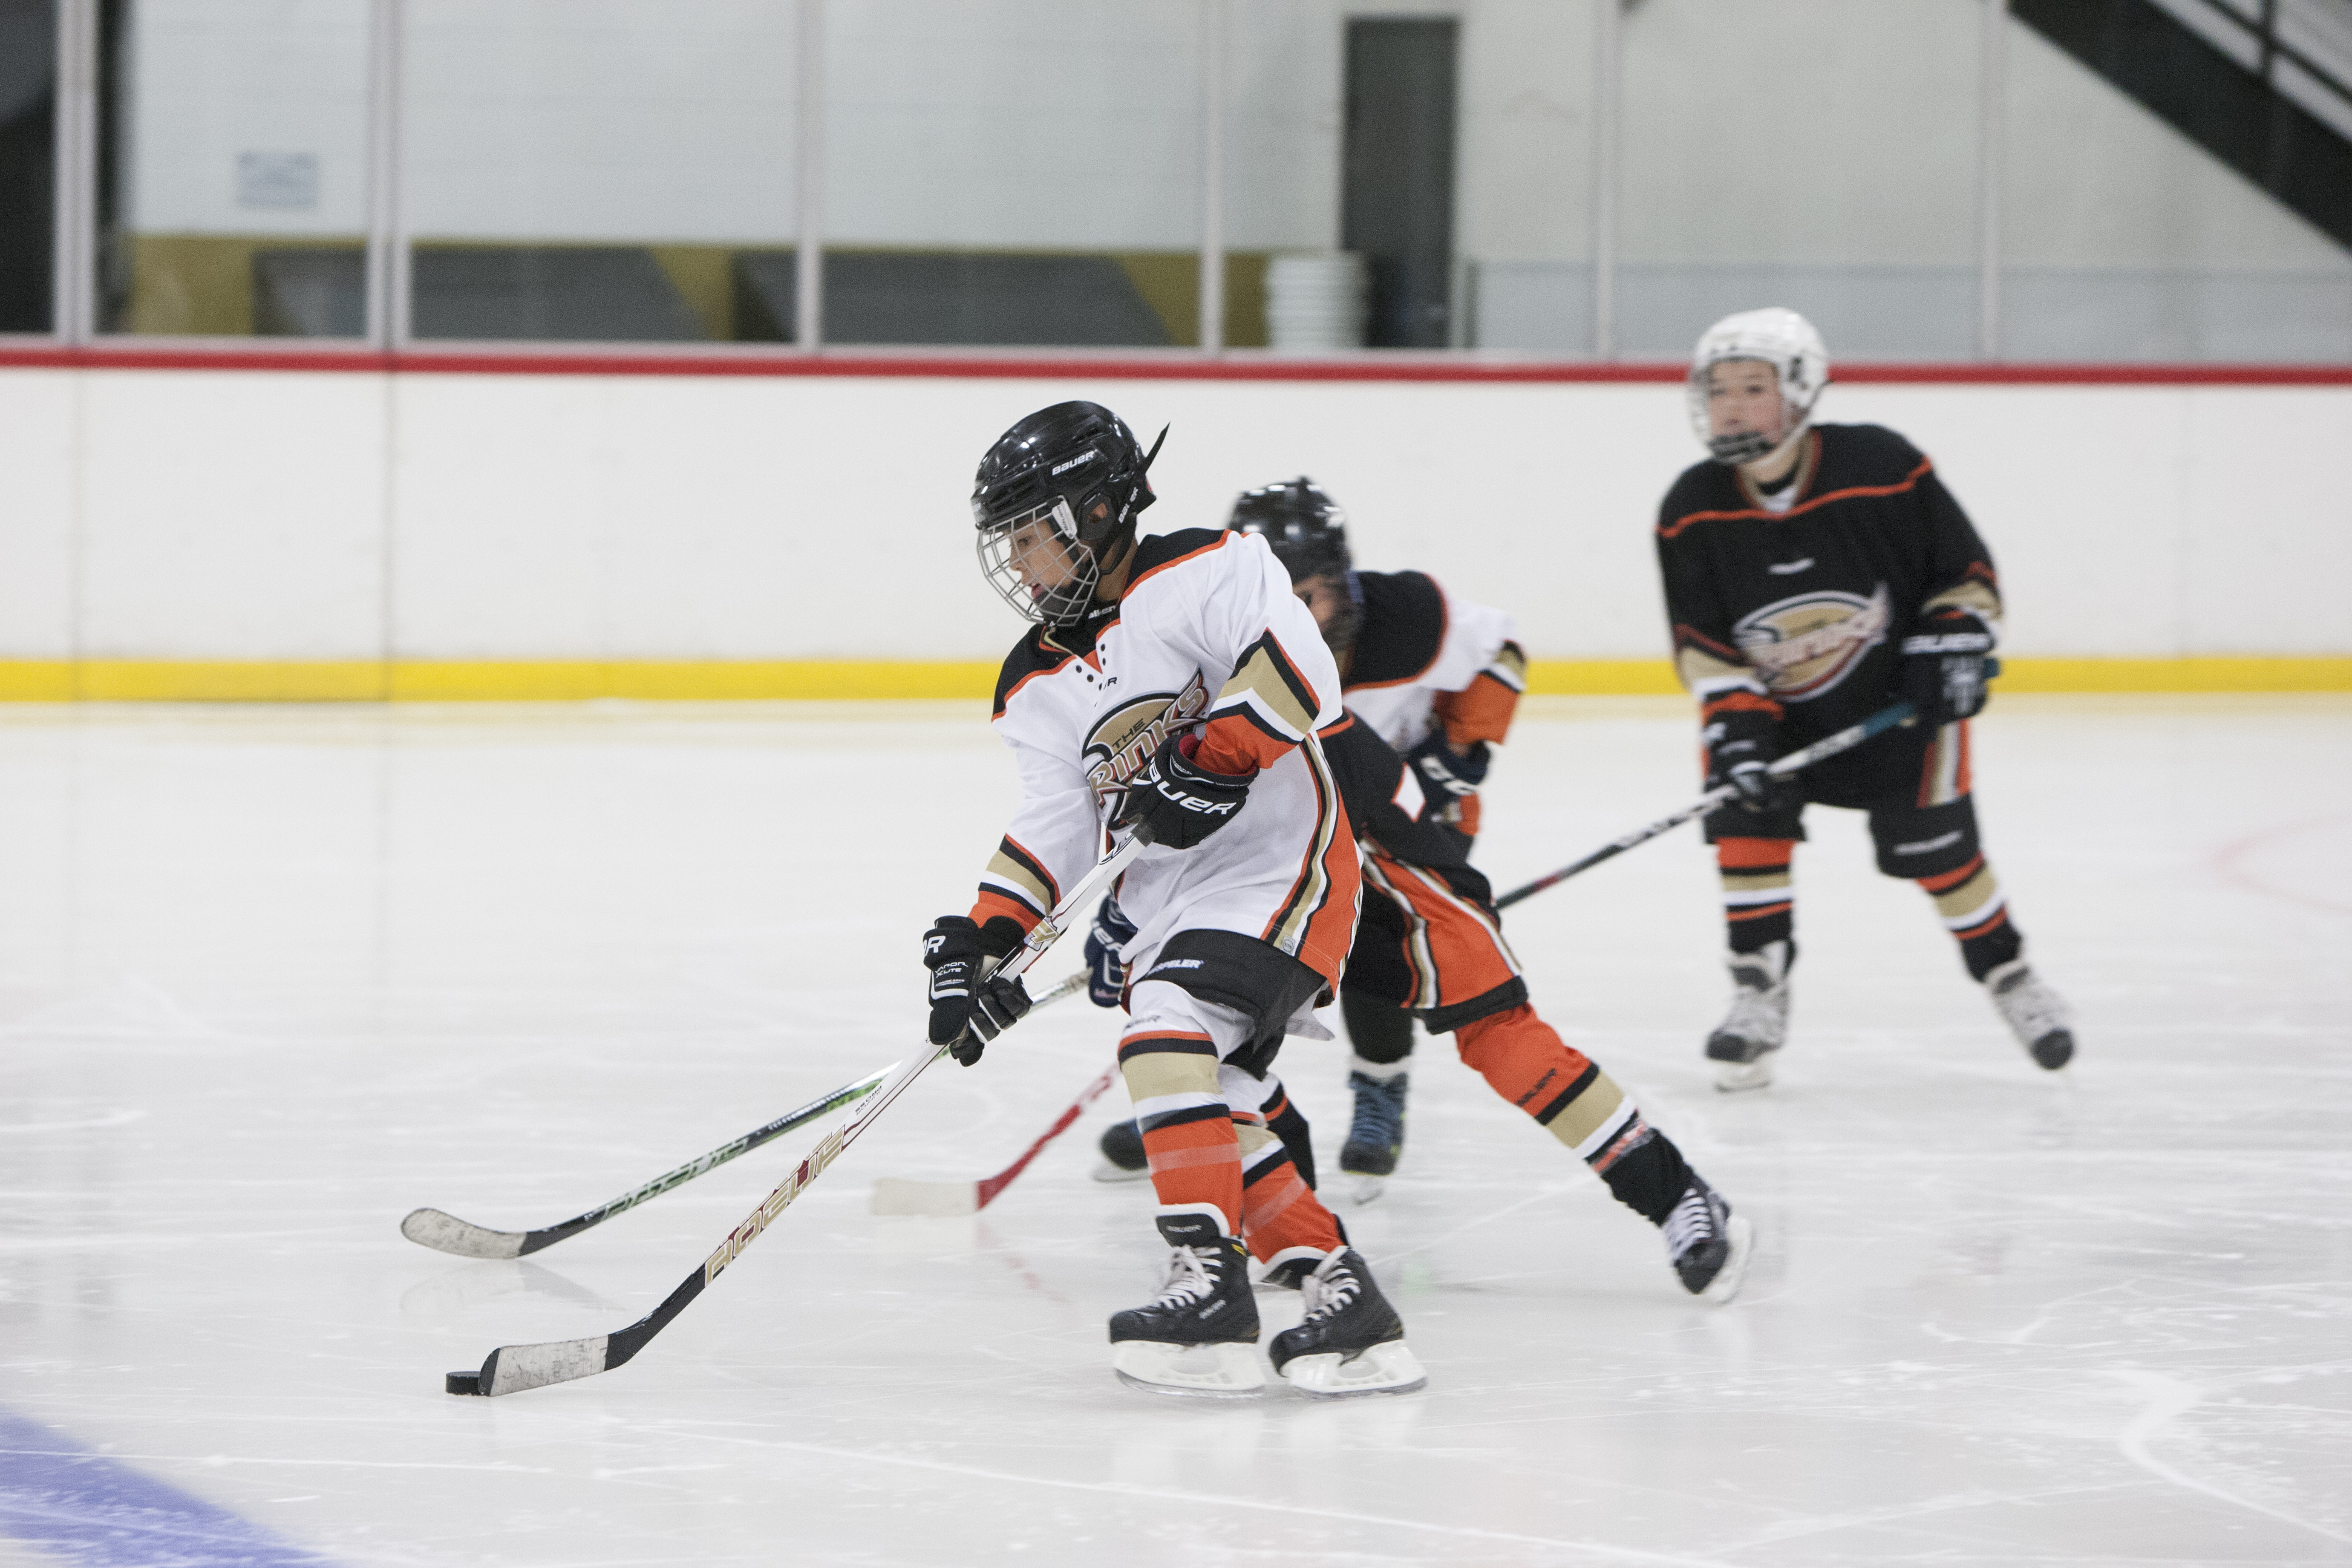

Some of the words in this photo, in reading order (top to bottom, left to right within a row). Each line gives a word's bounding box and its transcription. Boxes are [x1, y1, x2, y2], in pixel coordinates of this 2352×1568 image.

[1051, 450, 1096, 475] BAUER
[1088, 670, 1209, 809] RINKS
[1112, 718, 1145, 750] THE
[1148, 756, 1238, 815] AUER
